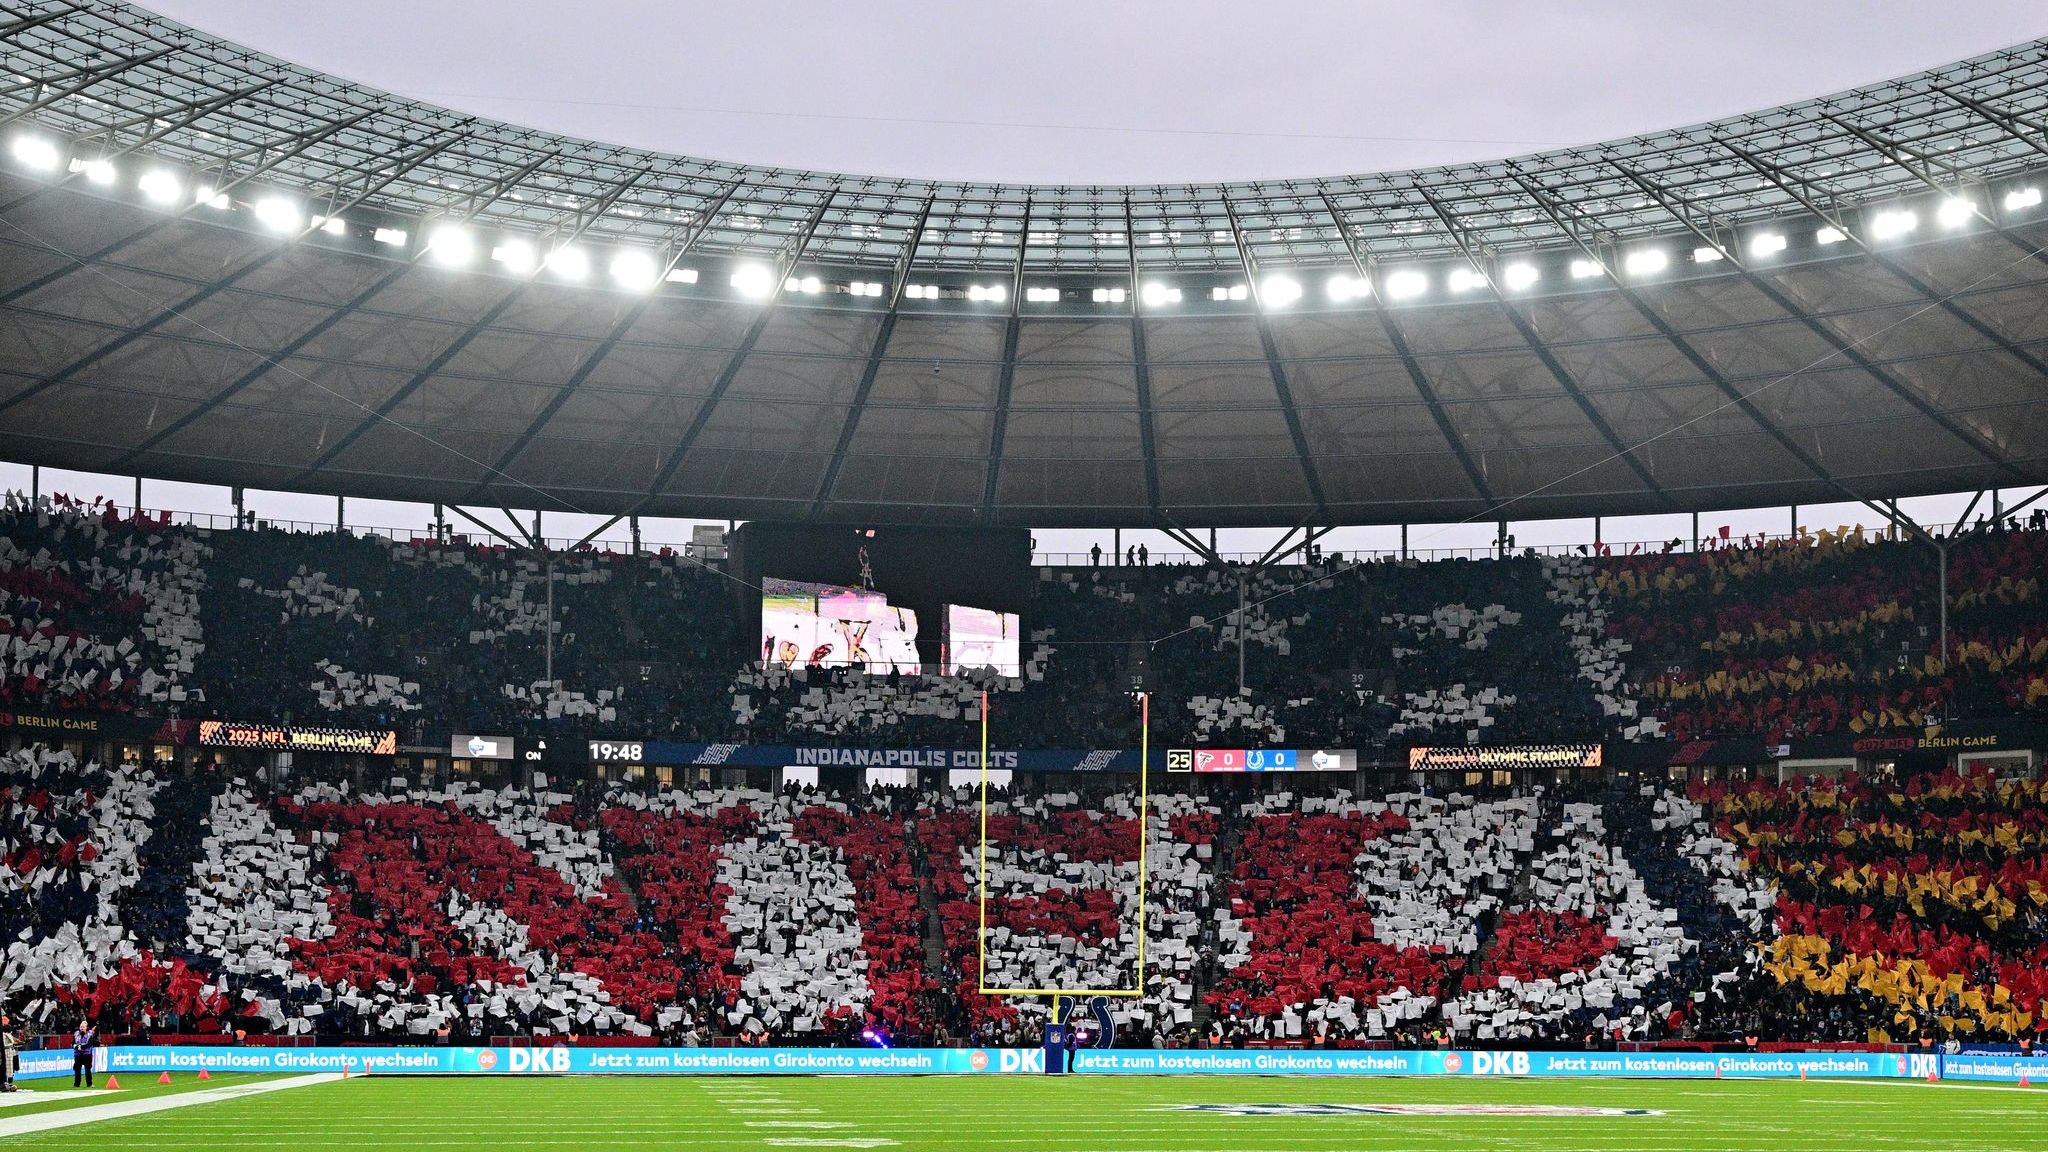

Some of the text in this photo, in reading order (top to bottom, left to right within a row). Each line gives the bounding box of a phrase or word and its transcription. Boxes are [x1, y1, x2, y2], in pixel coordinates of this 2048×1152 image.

[640, 666, 652, 675] 37
[1352, 673, 1364, 683] 39
[1130, 675, 1143, 685] 38
[17, 715, 60, 728] BERLIN
[62, 719, 98, 731] GAME
[228, 729, 373, 748] 2025 NFL BERLIN GAME
[1918, 736, 1959, 749] BERLIN
[1962, 735, 1998, 747] GAME
[525, 751, 542, 761] ON
[589, 743, 643, 761] 19:48
[795, 748, 946, 767] INDIANAPOLIS
[1223, 753, 1234, 766] 0
[1274, 753, 1285, 766] 0
[1479, 751, 1529, 763] OLYMPIC
[1529, 750, 1580, 762] STADIUM
[1168, 754, 1190, 769] 25
[112, 1052, 439, 1067] Jetzt zum kostenlosen Girokonto wechseln
[480, 1056, 494, 1064] 0€
[509, 1047, 571, 1072] DKB
[589, 1053, 932, 1068] Jetzt zum kostenlosen Girokonto wechseln
[1076, 1054, 1408, 1070] Jetzt zum kostenlosen Girokonto wechseln
[1446, 1058, 1459, 1067] 0€
[1472, 1051, 1531, 1075] DKB
[1546, 1056, 1869, 1072] Jetzt zum kostenlosen Girokonto wechseln
[1911, 1054, 1937, 1077] DKB
